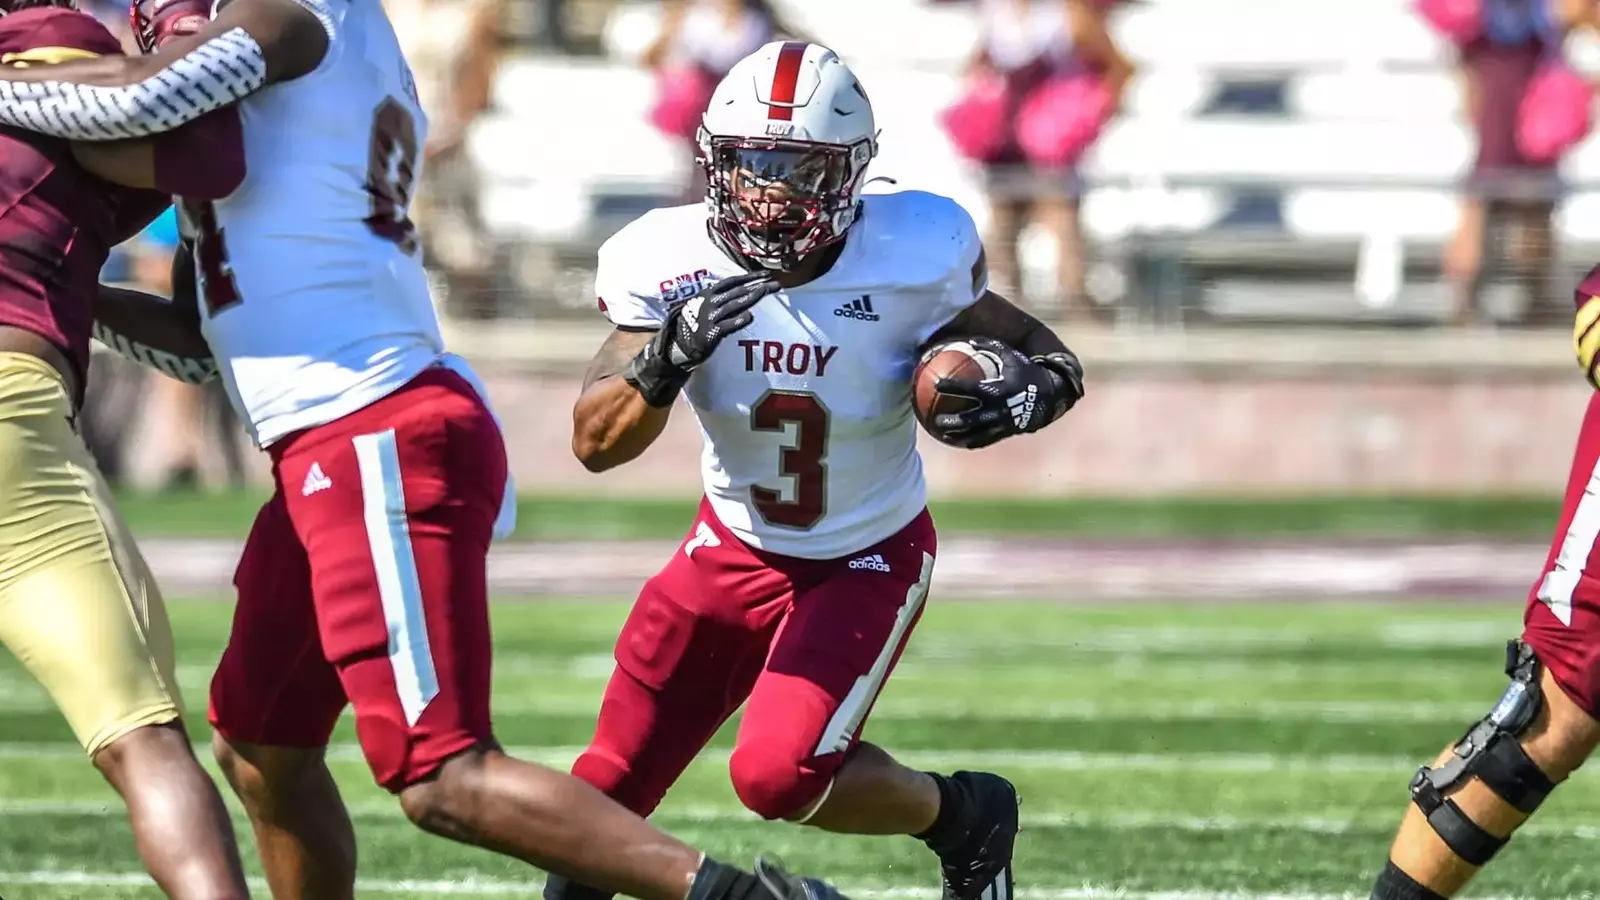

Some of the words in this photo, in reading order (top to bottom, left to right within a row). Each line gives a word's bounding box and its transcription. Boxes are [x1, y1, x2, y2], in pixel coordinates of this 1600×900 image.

[764, 123, 795, 136] TROY
[833, 308, 880, 322] adidas
[738, 340, 839, 377] TROY
[1019, 384, 1038, 430] adidas
[750, 388, 831, 532] 3
[848, 559, 891, 573] adidas
